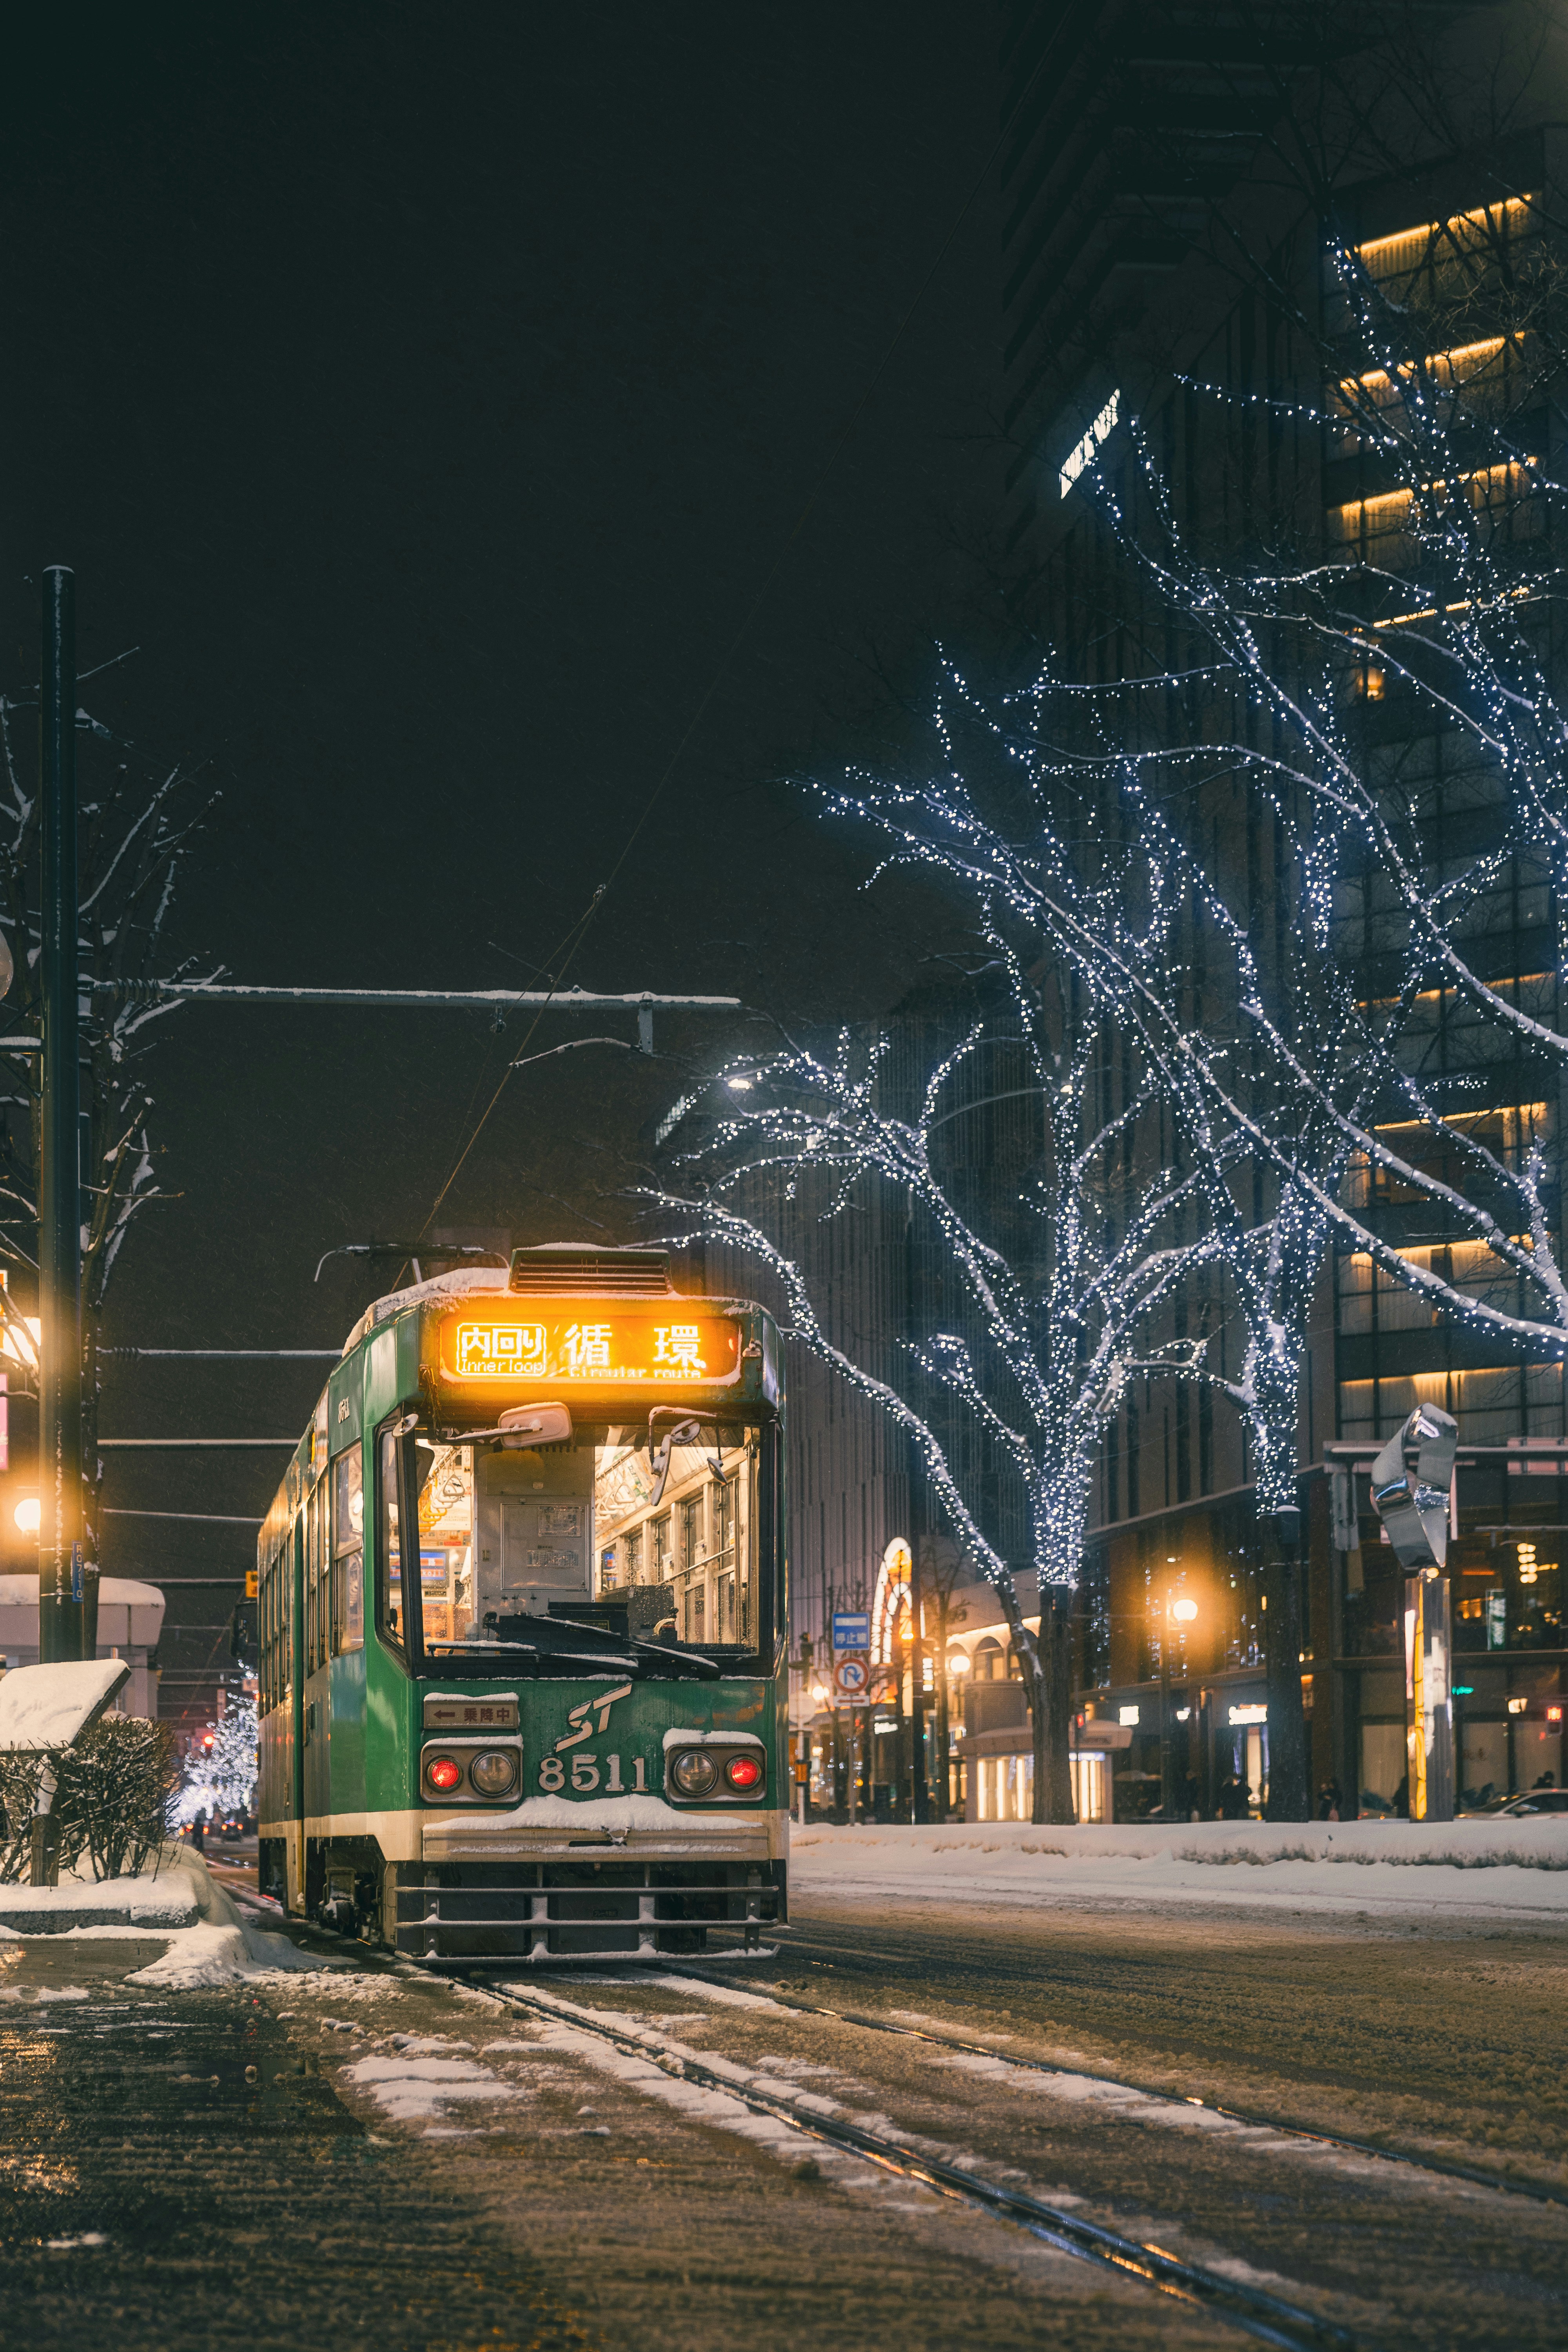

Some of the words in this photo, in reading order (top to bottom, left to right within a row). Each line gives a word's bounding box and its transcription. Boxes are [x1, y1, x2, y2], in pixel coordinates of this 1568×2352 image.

[461, 1327, 542, 1358] 内回り
[461, 1359, 506, 1372] Inner
[510, 1359, 543, 1374] loop
[570, 1366, 646, 1377] Circular
[654, 1368, 701, 1378] route
[464, 1708, 510, 1722] 乗降中
[539, 1754, 649, 1791] 8511
